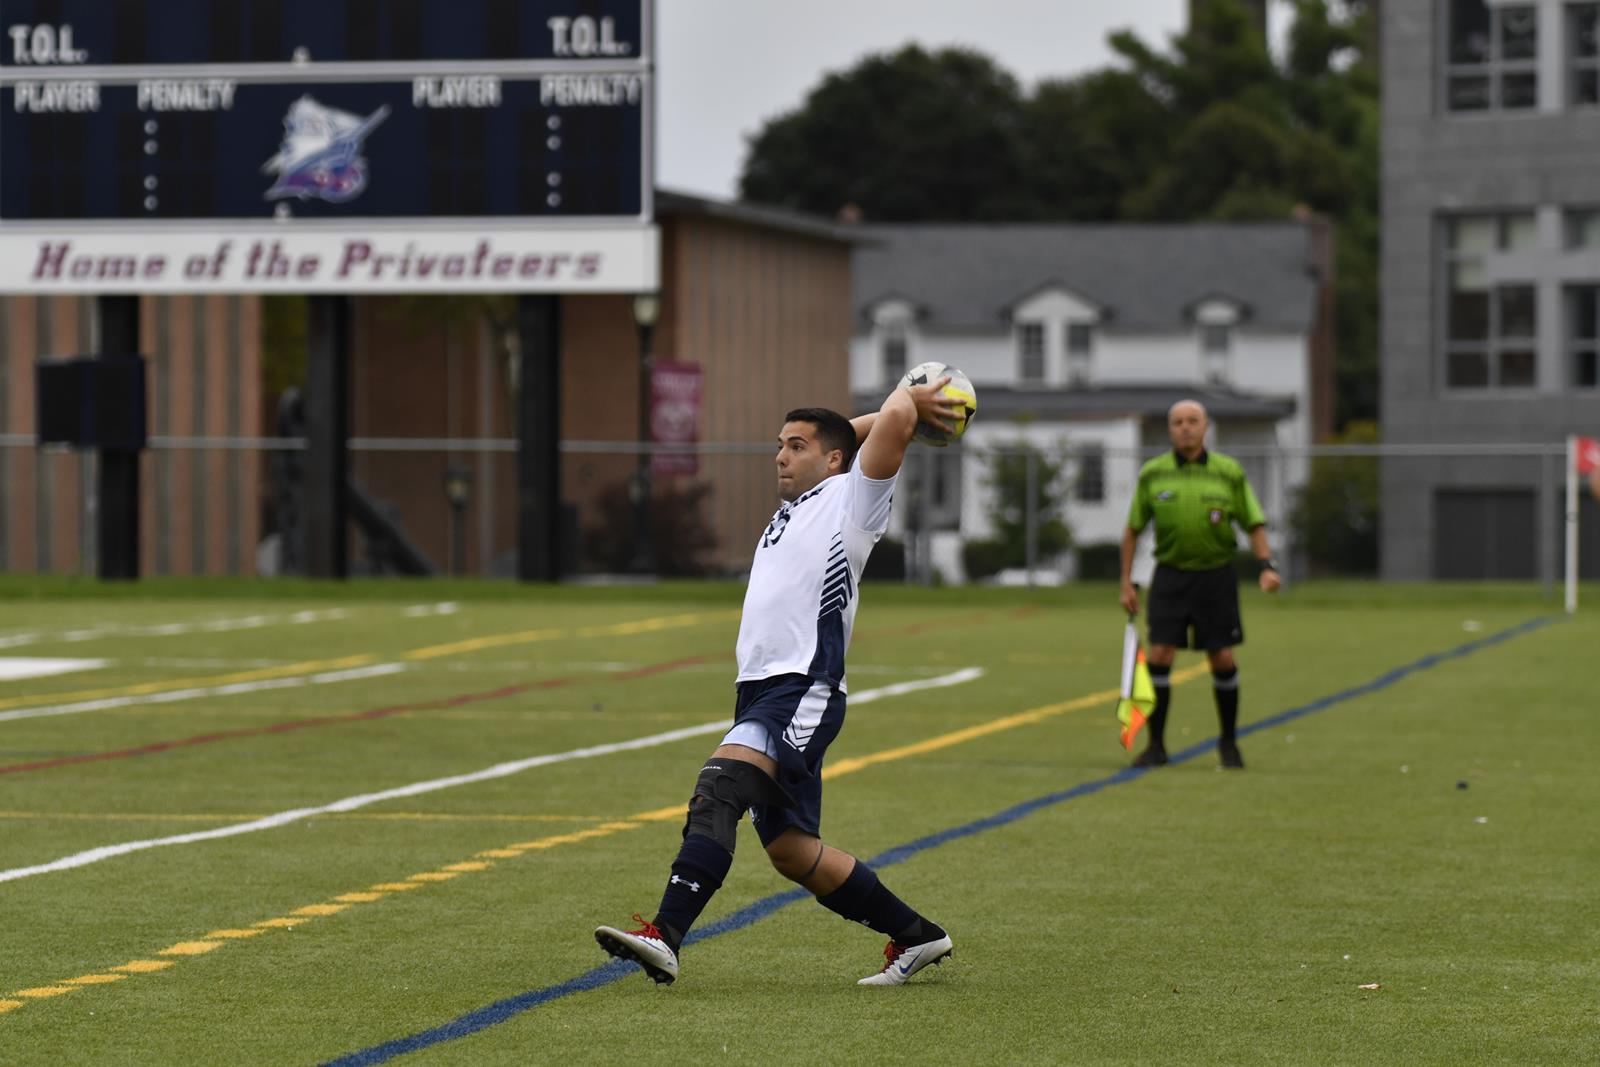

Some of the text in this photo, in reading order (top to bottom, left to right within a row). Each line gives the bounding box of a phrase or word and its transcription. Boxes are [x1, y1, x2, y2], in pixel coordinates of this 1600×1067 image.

[9, 24, 87, 64] T.O.L.
[547, 16, 632, 55] T.O.L.
[14, 79, 236, 113] PLAYER PENALTY
[412, 74, 641, 107] PLAYER PENALTY
[33, 240, 603, 280] Home of the Privateers
